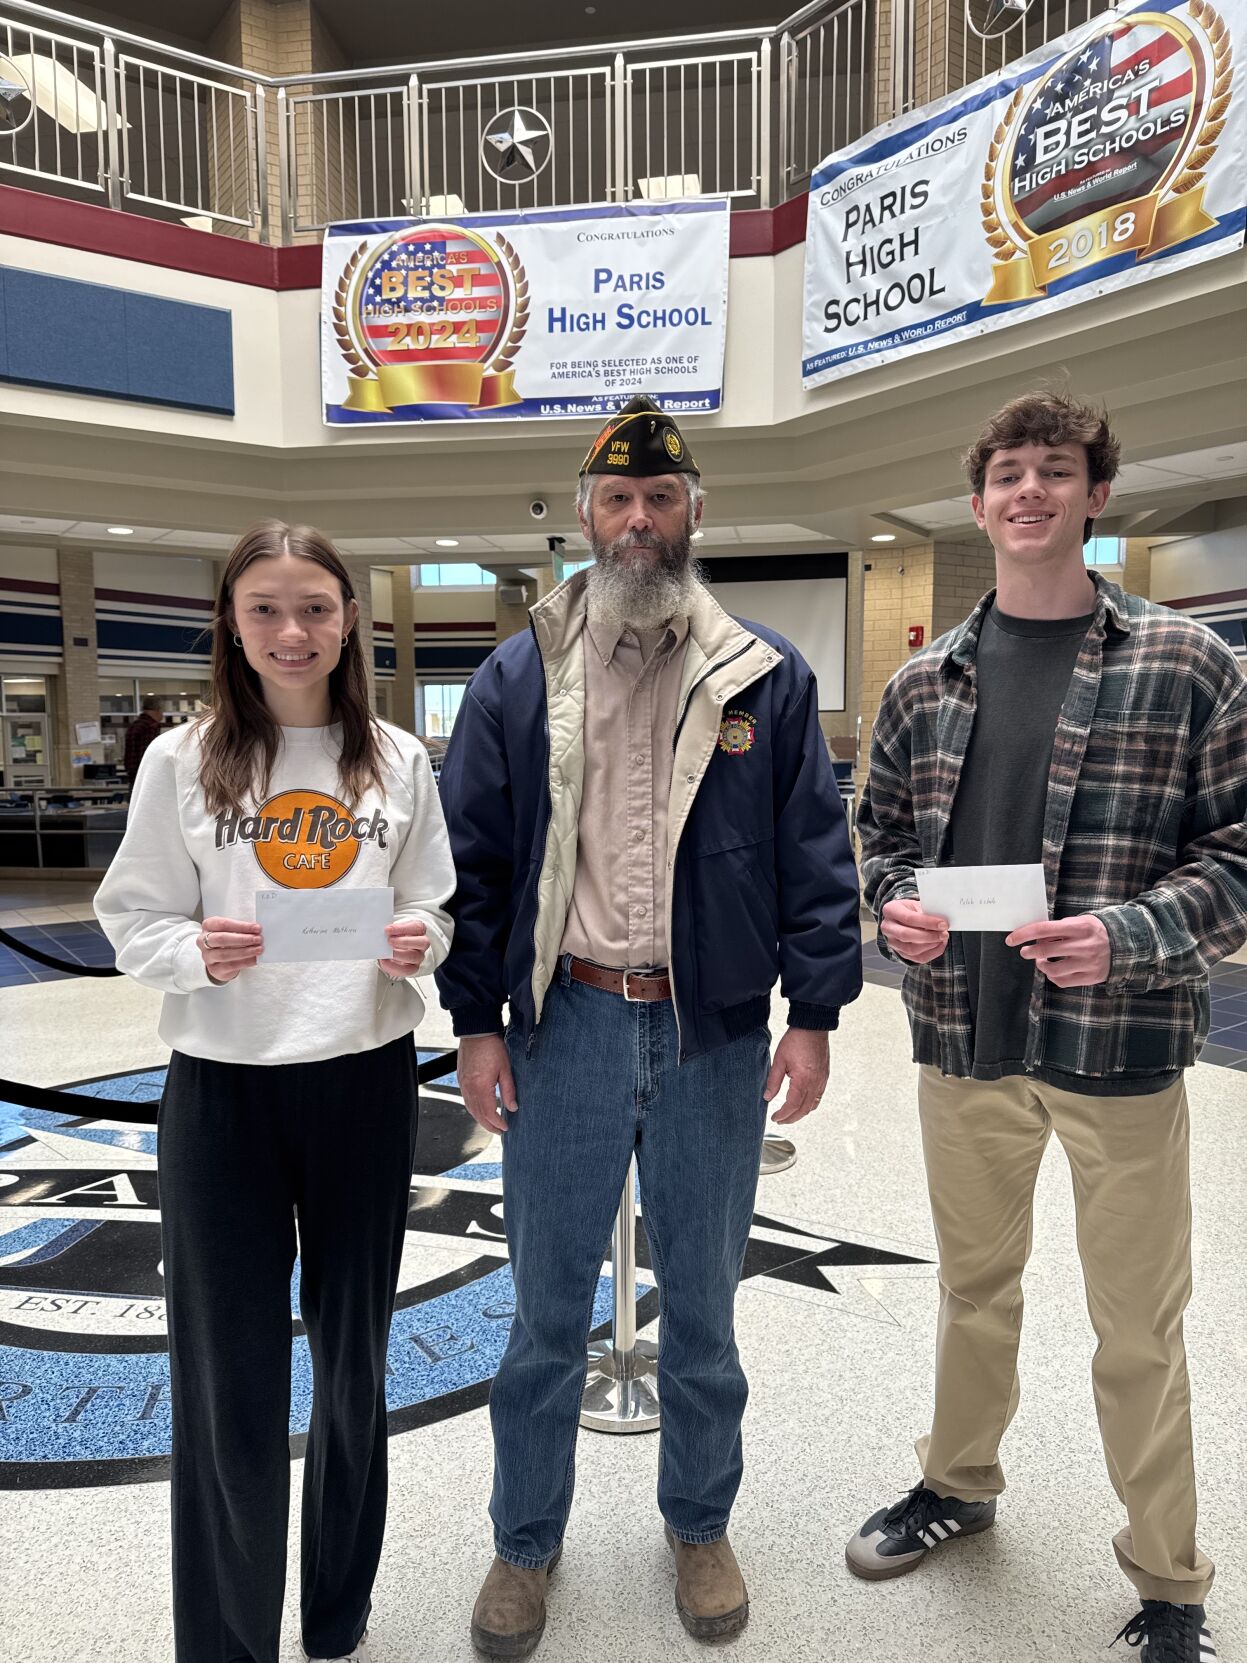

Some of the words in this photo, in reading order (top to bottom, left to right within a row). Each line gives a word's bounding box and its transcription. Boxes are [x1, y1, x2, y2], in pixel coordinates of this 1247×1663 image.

[1051, 59, 1150, 117] AMERICA'S
[1034, 76, 1161, 166] BEST
[820, 127, 968, 206] CONGRATULATIONS
[1013, 158, 1066, 196] HIGH
[1074, 109, 1186, 169] SCHOOLS
[1067, 185, 1085, 196] News
[1092, 172, 1112, 186] World
[1113, 162, 1138, 177] Report
[841, 179, 931, 243] PARIS
[577, 228, 675, 242] CONGRATULATIONS
[1048, 212, 1136, 269] 2018
[394, 252, 468, 266] AMERICA'S
[845, 226, 920, 284] HIGH
[381, 267, 480, 299] BEST
[594, 268, 665, 293] PARIS
[363, 304, 405, 318] HIGH
[411, 299, 498, 315] SCHOOLS
[823, 267, 946, 333] SCHOOL
[548, 306, 605, 333] HIGH
[616, 303, 712, 329] SCHOOL
[867, 338, 893, 350] NEWS
[894, 334, 900, 343] &
[901, 324, 933, 340] WORLD
[934, 311, 967, 330] REPORT
[387, 319, 480, 350] 2024
[550, 362, 567, 370] FOR
[571, 360, 598, 369] BEING
[601, 358, 647, 368] SELECTED
[650, 357, 662, 365] AS
[665, 356, 684, 364] ONE
[687, 355, 700, 364] OF
[551, 368, 601, 379] AMERICA'S
[603, 369, 627, 378] BEST
[629, 367, 652, 376] HIGH
[655, 365, 698, 375] SCHOOLS
[604, 379, 617, 387] OF
[619, 378, 642, 387] 2024
[541, 404, 565, 414] U.S.
[567, 403, 602, 413] News
[606, 401, 616, 411] &
[664, 398, 711, 410] Report
[611, 441, 629, 452] VFW
[728, 709, 757, 724] MEMBER
[215, 807, 304, 850] Hard
[308, 805, 389, 850] Rock
[283, 853, 330, 869] CAFE
[10, 1296, 101, 1316] EST.
